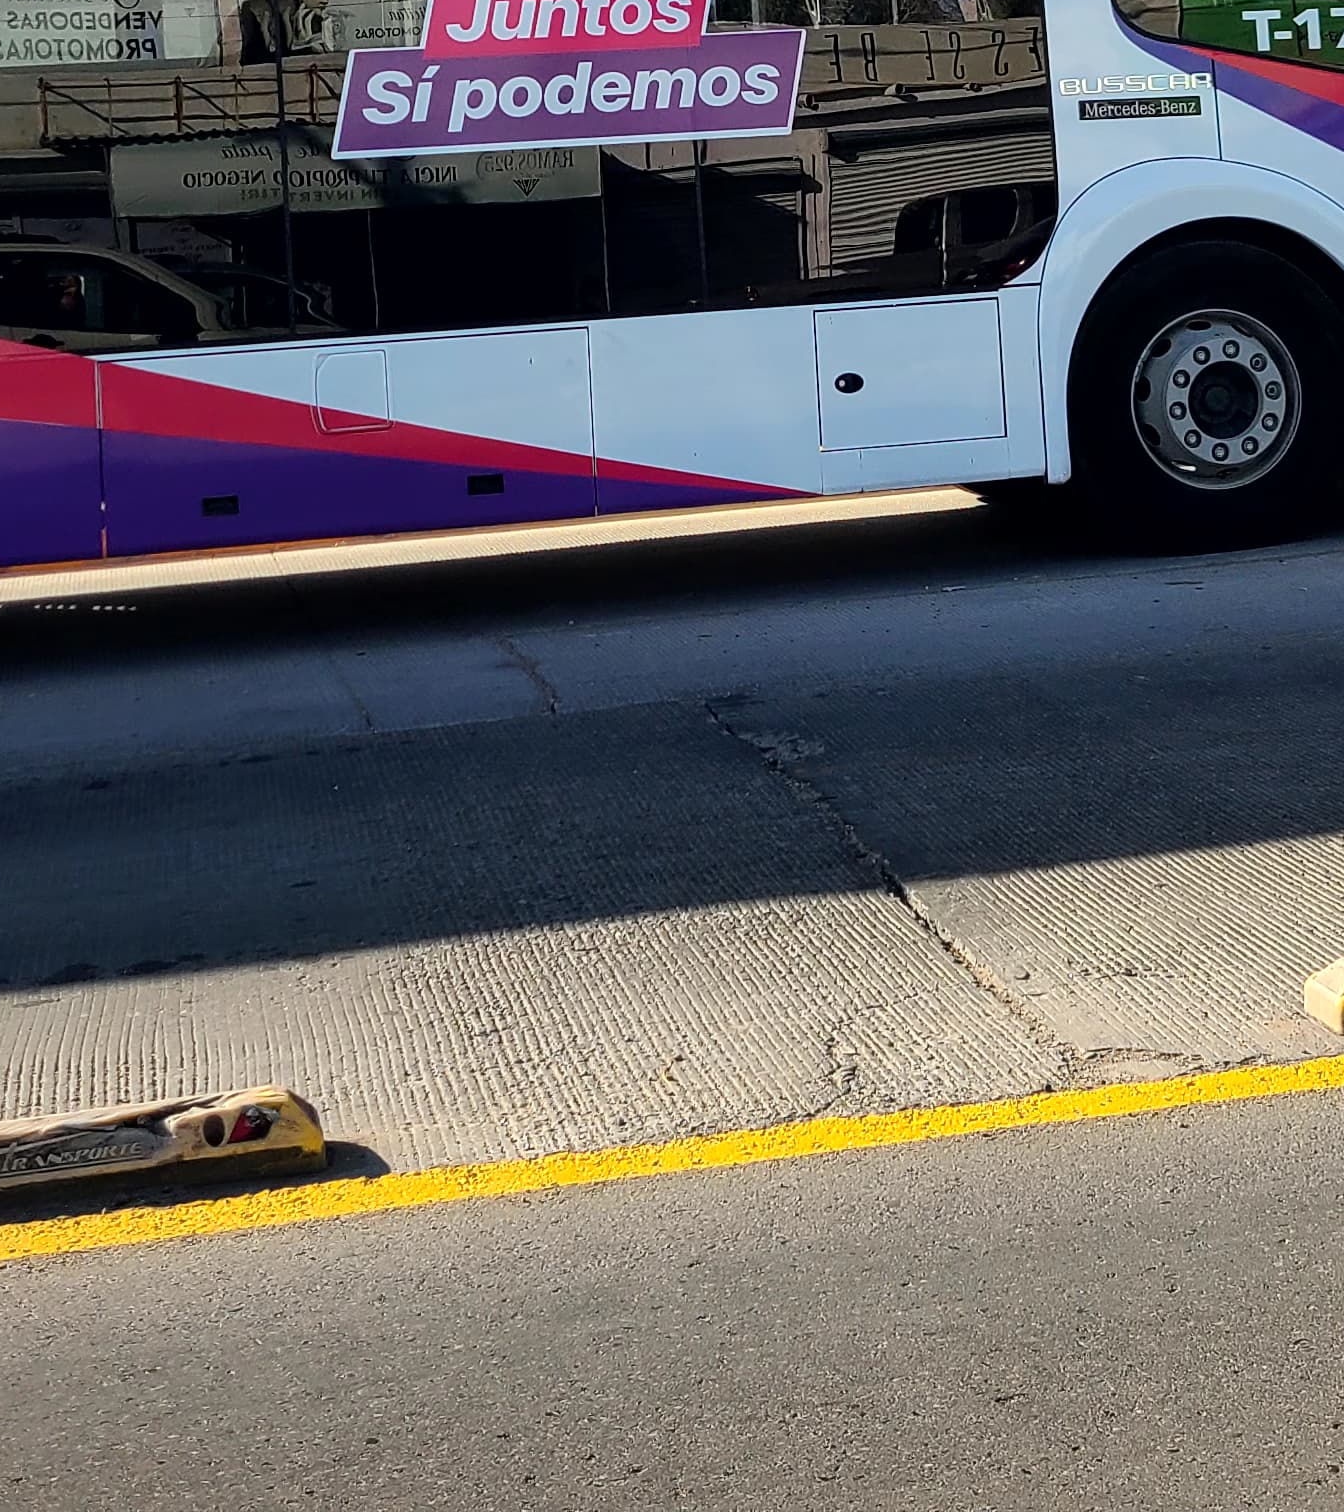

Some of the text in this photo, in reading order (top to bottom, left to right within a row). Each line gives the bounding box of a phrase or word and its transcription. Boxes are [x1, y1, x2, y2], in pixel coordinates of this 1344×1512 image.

[1059, 73, 1213, 96] BUSSCAR
[361, 62, 780, 133] Sí podemos
[1084, 100, 1197, 118] Mercedes-Benz
